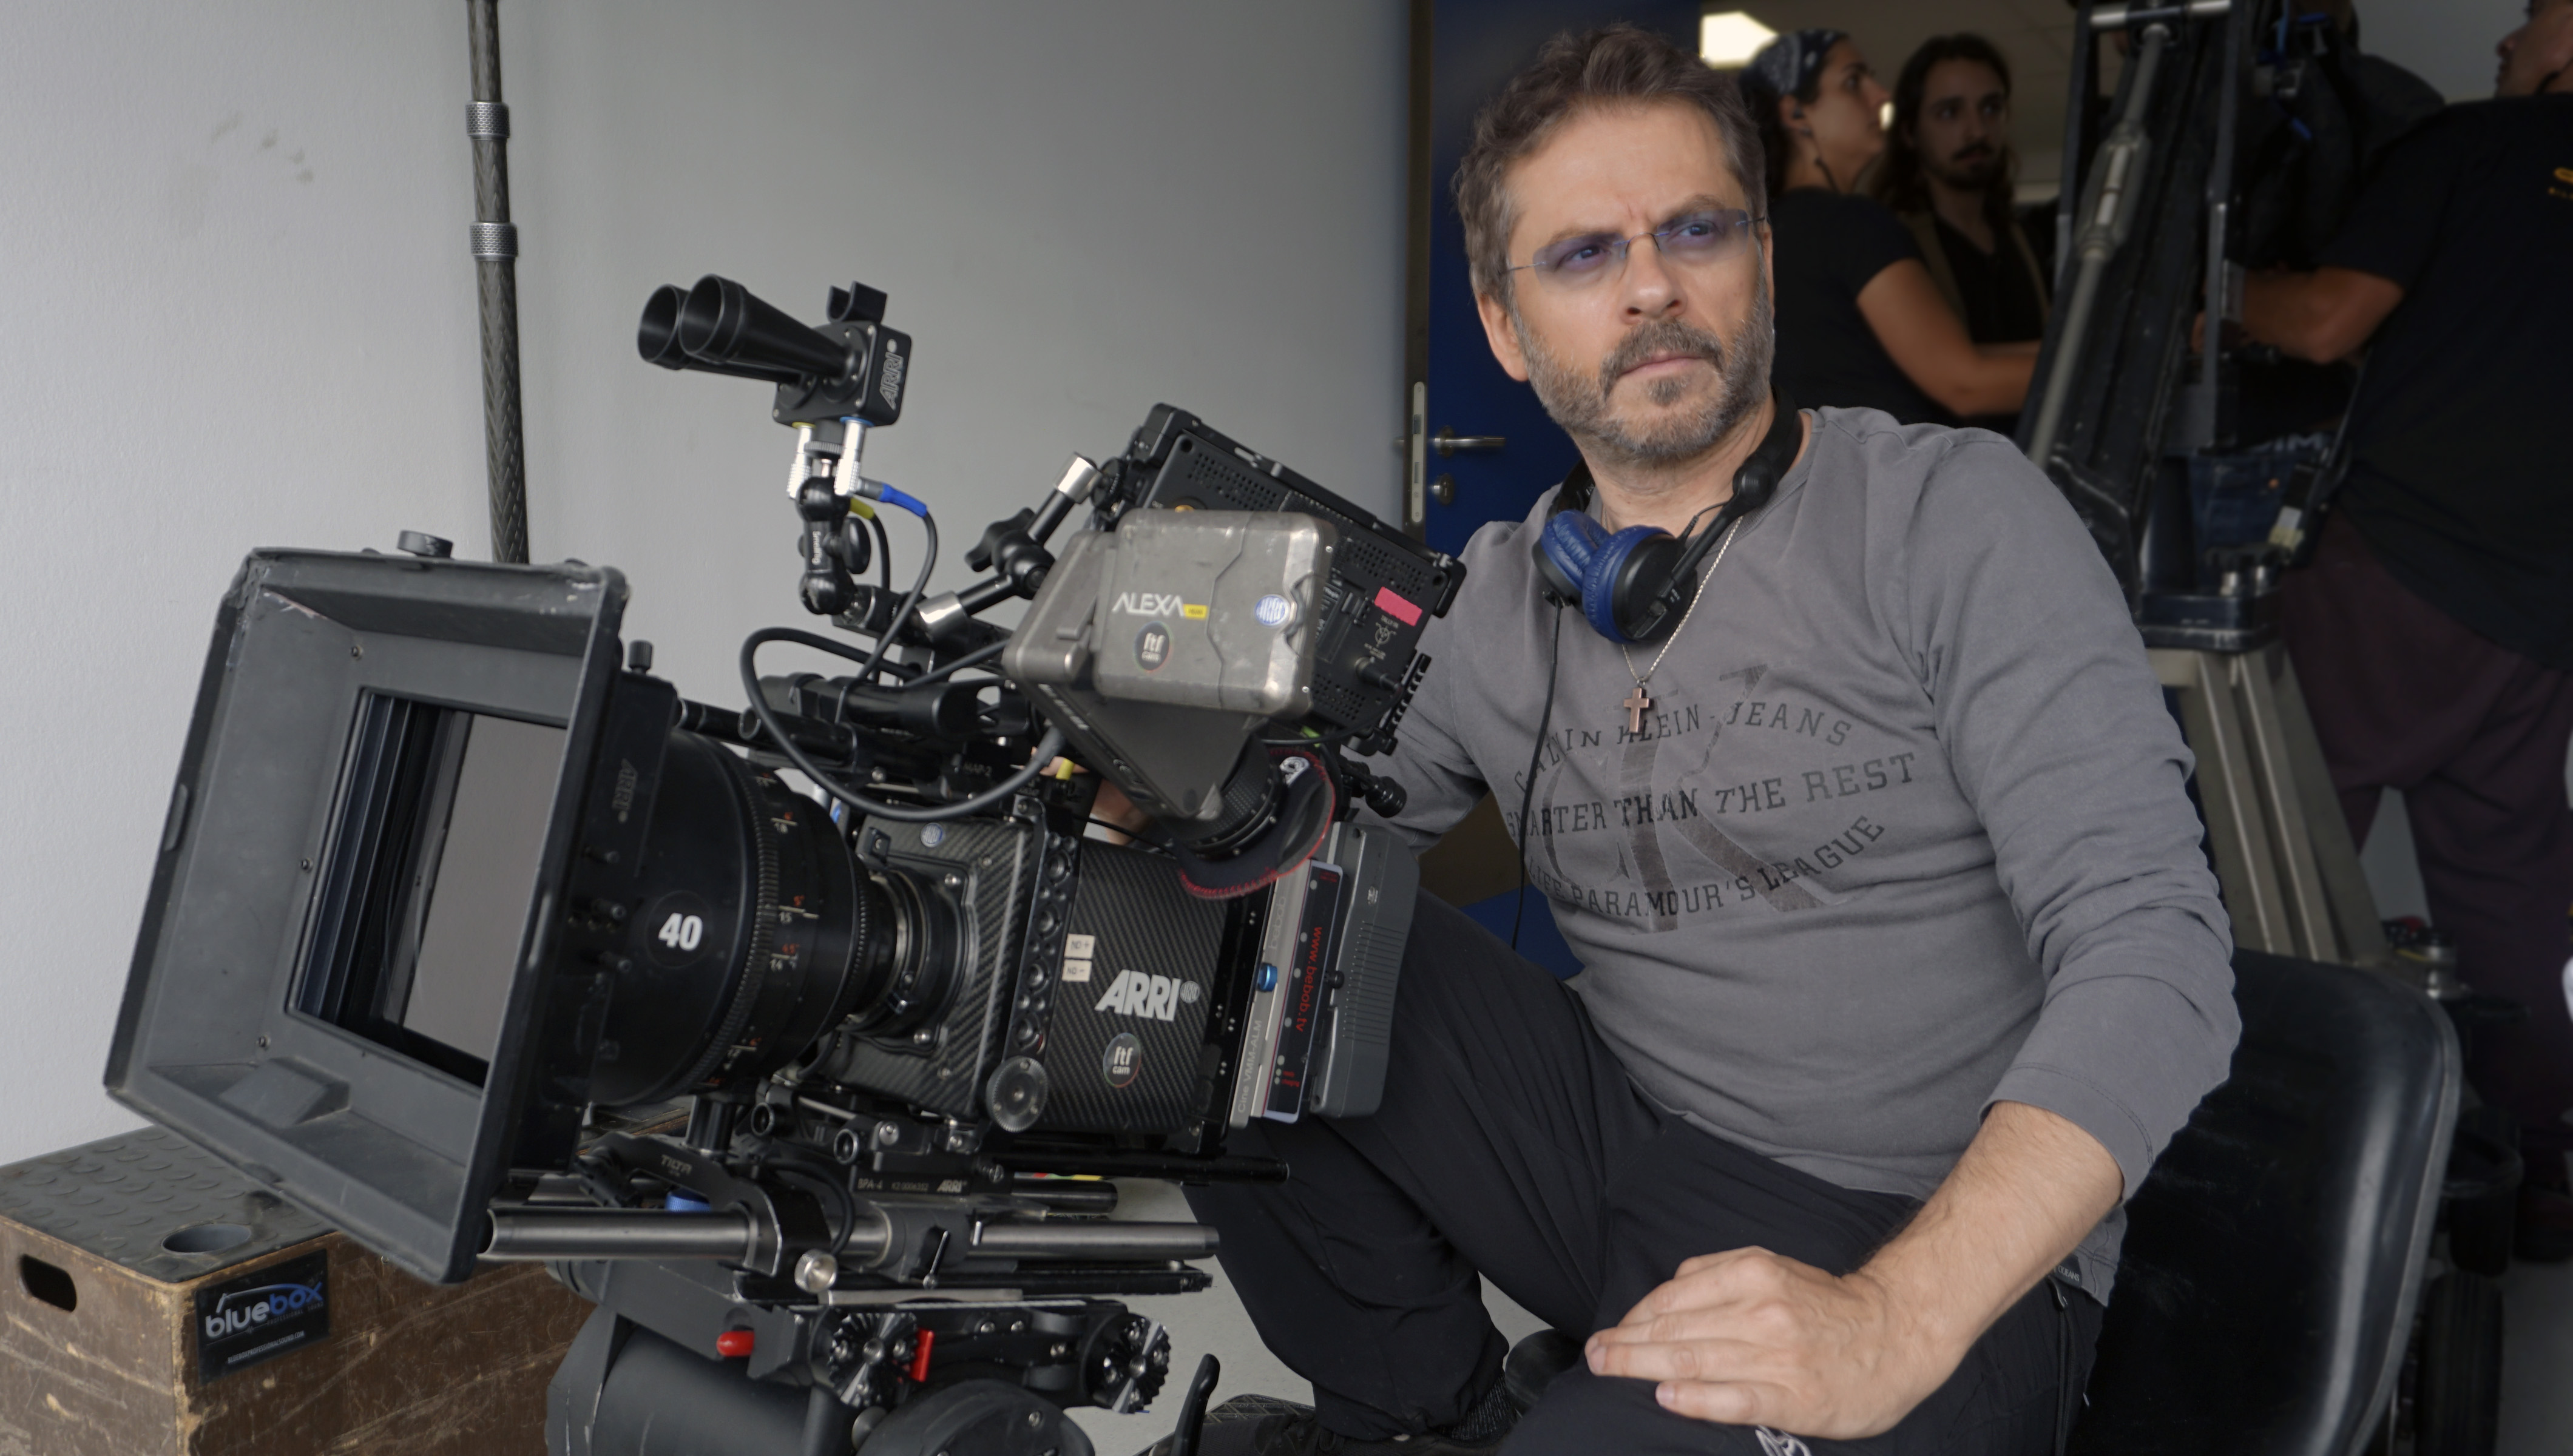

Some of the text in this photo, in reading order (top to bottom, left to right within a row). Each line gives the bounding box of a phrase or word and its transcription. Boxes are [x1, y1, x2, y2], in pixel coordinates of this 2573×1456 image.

[879, 351, 904, 411] ARRI
[1111, 592, 1185, 618] ALEXA
[1726, 702, 1851, 746] JEANS
[1614, 788, 1698, 827] THAN
[1715, 778, 1786, 814] THE
[1801, 752, 1915, 803] REST
[1571, 876, 1756, 916] PARAMOUR'S
[1757, 815, 1885, 891] LEAGUE
[658, 912, 703, 951] 40
[1094, 969, 1182, 1022] ARRI
[1296, 926, 1322, 1032] www.bebob.tv
[1112, 1065, 1131, 1076] cam
[1114, 1045, 1134, 1066] ftf
[1238, 1020, 1263, 1113] Cine VMM-ALM
[936, 1179, 964, 1193] ARRI
[205, 1282, 323, 1338] bluebox
[267, 1309, 303, 1325] PROFESSIONAL
